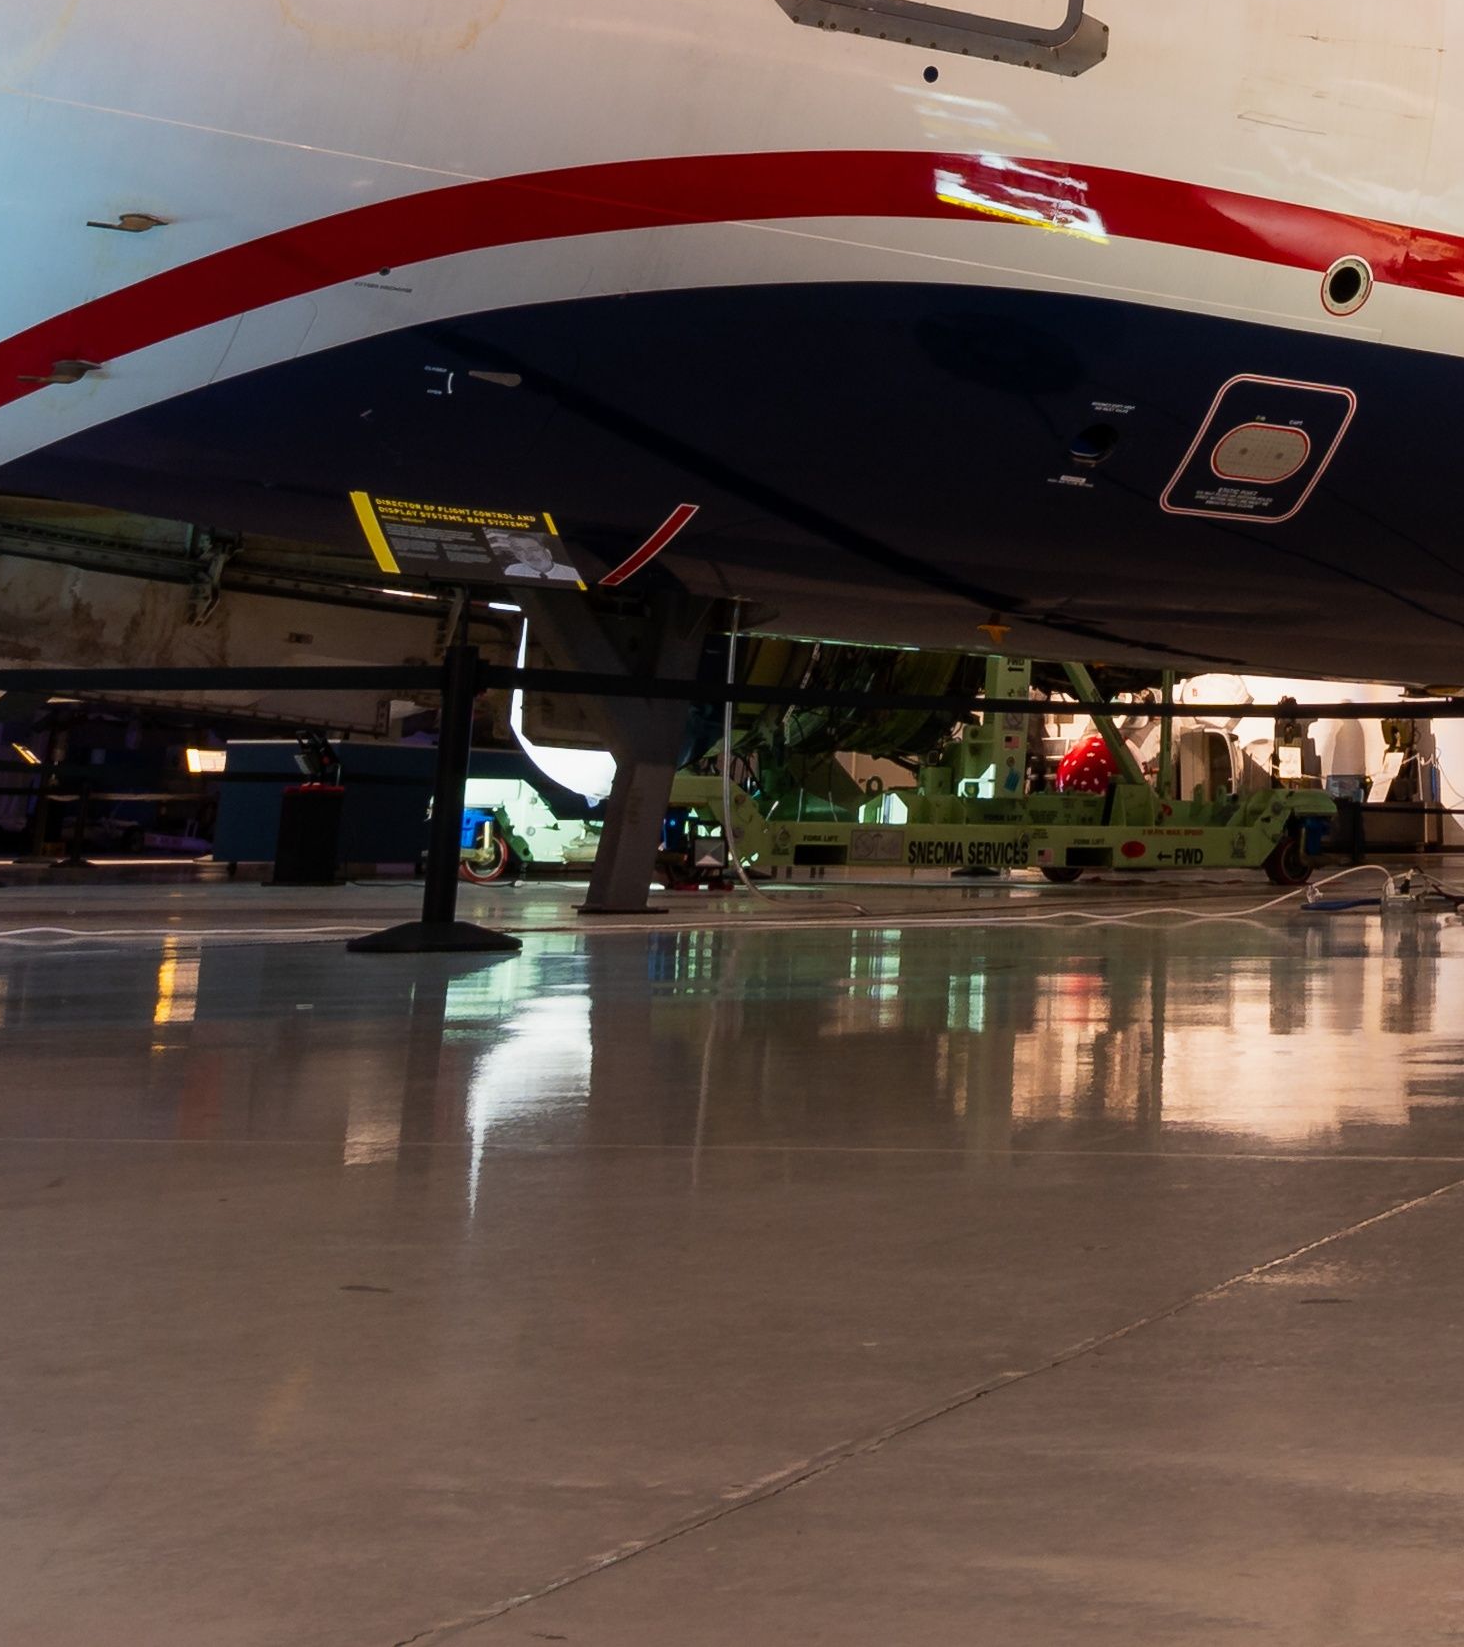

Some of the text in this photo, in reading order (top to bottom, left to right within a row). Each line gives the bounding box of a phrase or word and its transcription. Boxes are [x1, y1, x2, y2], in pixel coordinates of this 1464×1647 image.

[375, 498, 537, 522] DIRECTOR OF FLIGHT CONTROL AND
[378, 506, 417, 517] DISPLAY
[419, 511, 466, 524] SYSTEMS,
[487, 518, 531, 529] SYSTEMS
[908, 840, 1029, 865] SNECMA SERVICES
[1174, 848, 1204, 865] FWD
